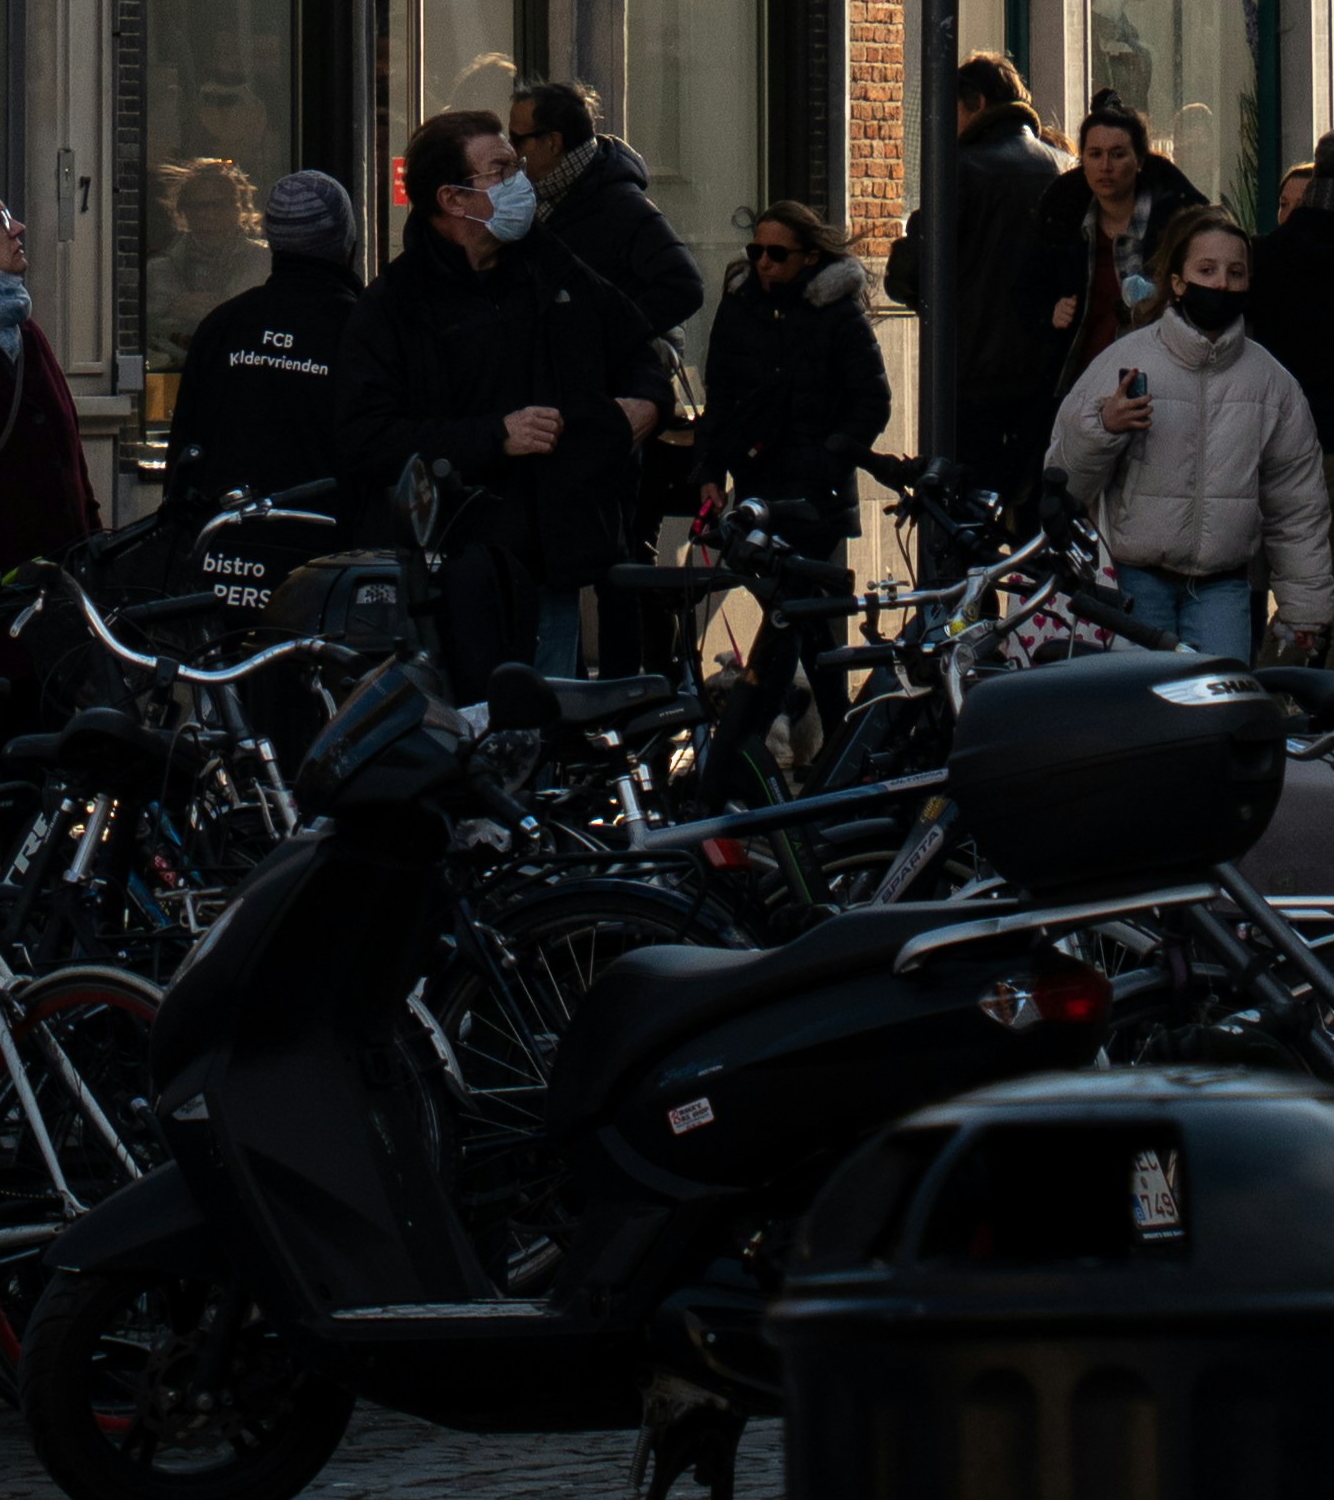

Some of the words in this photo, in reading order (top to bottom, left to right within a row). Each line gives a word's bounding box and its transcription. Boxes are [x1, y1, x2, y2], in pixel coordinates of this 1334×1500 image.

[79, 175, 91, 212] 7
[262, 329, 294, 348] FCB
[203, 551, 266, 577] bistro
[881, 829, 940, 904] SPARTA
